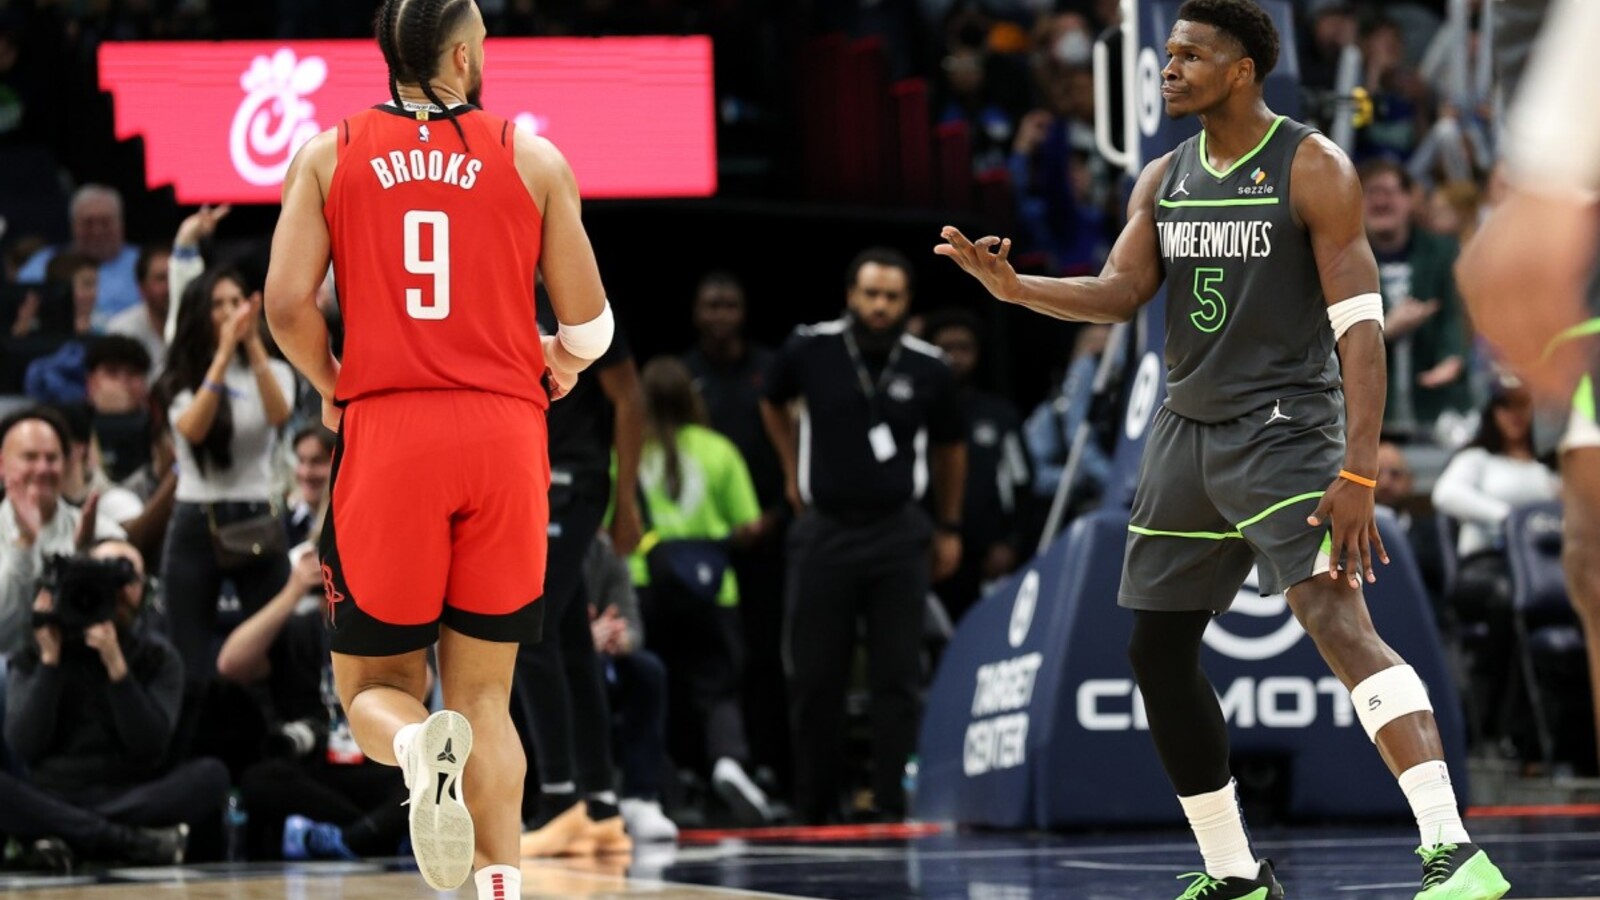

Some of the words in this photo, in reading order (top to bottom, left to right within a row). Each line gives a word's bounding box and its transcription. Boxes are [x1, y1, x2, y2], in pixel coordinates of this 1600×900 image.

[370, 149, 482, 189] BROOKS
[1238, 184, 1274, 194] sezzle
[1157, 221, 1272, 263] TIMBERWOLVES
[404, 210, 450, 319] 9
[1191, 268, 1227, 332] 5
[1368, 694, 1382, 711] 5
